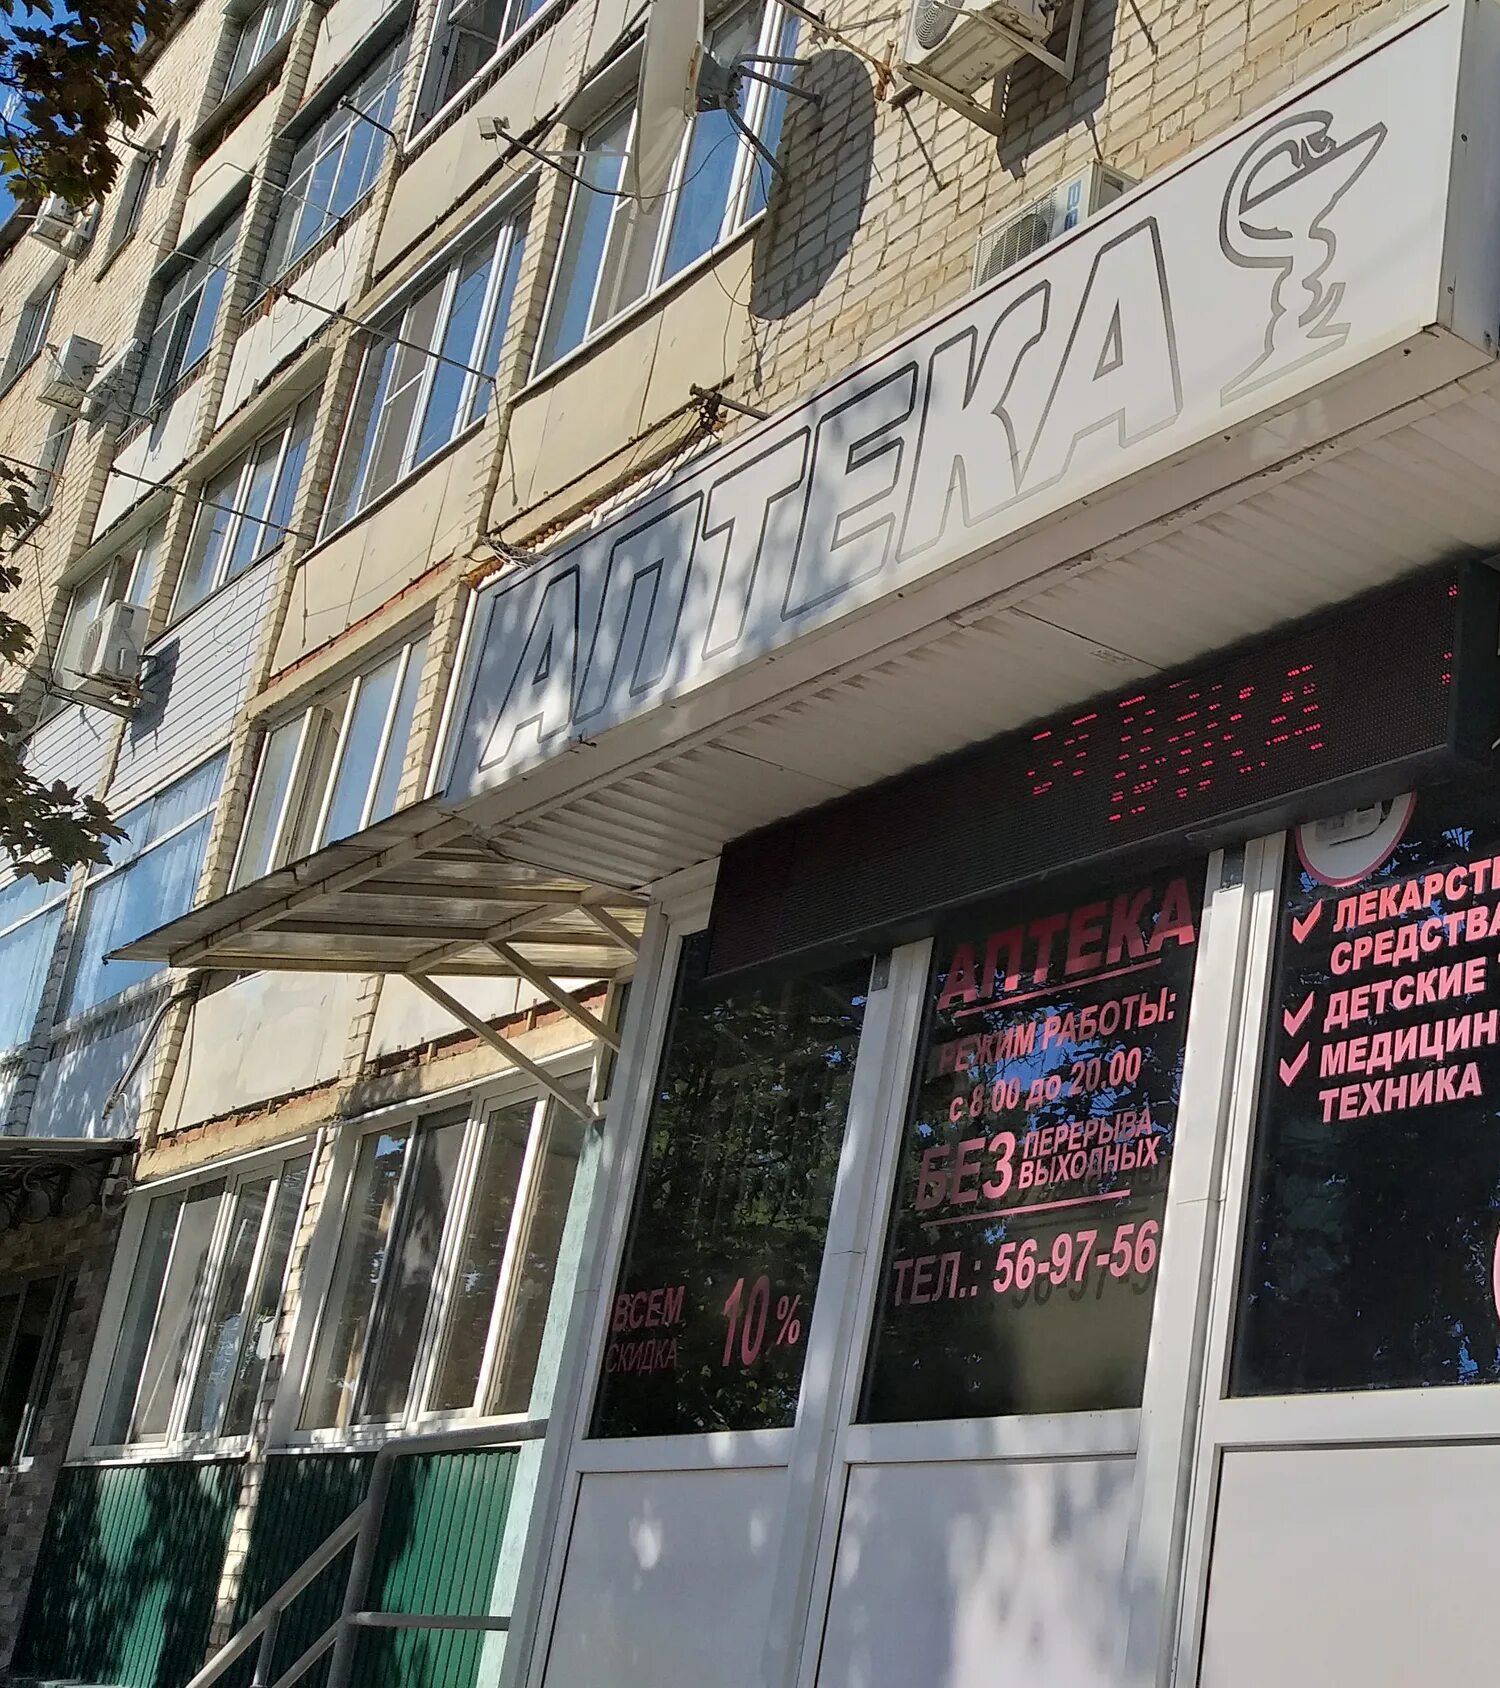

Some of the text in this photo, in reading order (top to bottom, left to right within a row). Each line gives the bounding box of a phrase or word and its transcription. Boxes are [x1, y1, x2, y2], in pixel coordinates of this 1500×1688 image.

[479, 215, 1184, 774] АПТЕКА
[936, 876, 1196, 1011] АПТЕКА
[937, 986, 1177, 1075] РЕЖИМ РАБОТЫ:
[1322, 956, 1486, 1034] ДЕТСКИЕ
[1024, 1074, 1062, 1112] до
[1070, 1046, 1143, 1098] 20.00
[1318, 1061, 1483, 1124] ТЕХНИКА
[914, 1106, 1153, 1211] БЕЗ ПЕРЕРЫВА
[1018, 1135, 1162, 1190] ВЫХОДНЫХ
[893, 1250, 979, 1307] ТЕЛ.:
[992, 1219, 1160, 1294] 56-97-56
[611, 1285, 686, 1332] ВСЕМ
[721, 1274, 771, 1367] 10
[604, 1335, 679, 1376] СКИДКА
